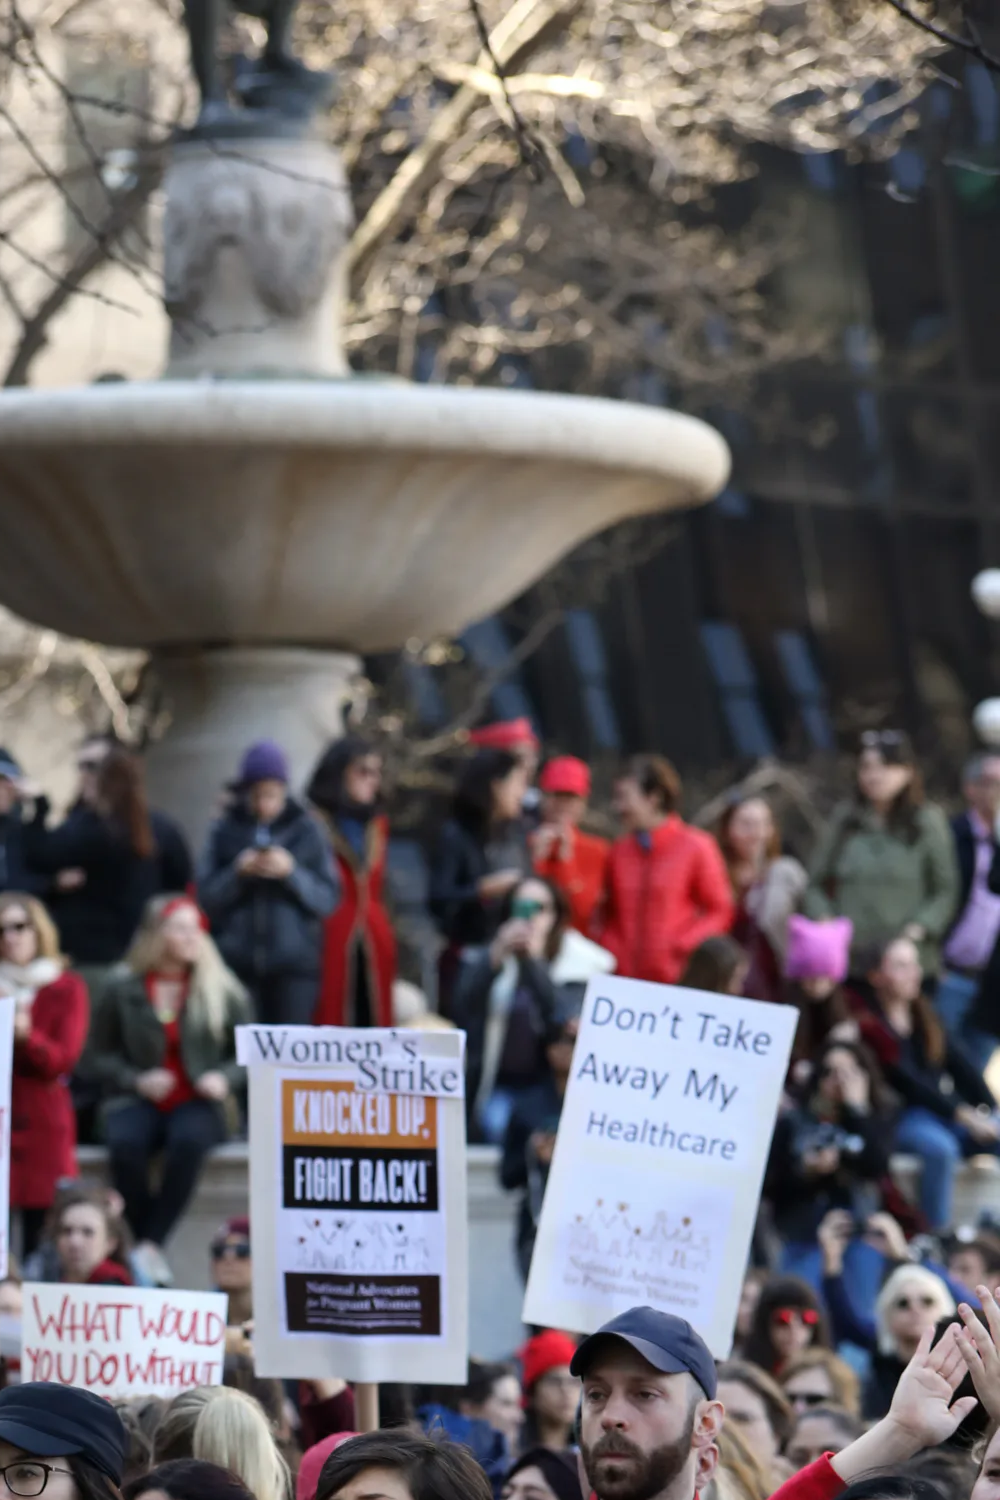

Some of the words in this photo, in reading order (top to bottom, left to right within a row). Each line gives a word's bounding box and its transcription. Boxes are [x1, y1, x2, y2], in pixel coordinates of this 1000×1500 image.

[252, 1029, 417, 1063] Women's
[590, 996, 683, 1040] Don't
[697, 1012, 772, 1056] Take
[358, 1059, 459, 1093] Strike
[576, 1052, 669, 1100] Away
[684, 1068, 738, 1112] My
[293, 1089, 391, 1135] KNOCKED
[586, 1110, 737, 1161] Healthcare
[293, 1157, 354, 1202] FIGHT
[359, 1158, 428, 1203] BACK!
[32, 1293, 134, 1343] WHAT
[138, 1302, 226, 1346] WOULD
[25, 1347, 78, 1385] YOU
[84, 1349, 119, 1386] DO
